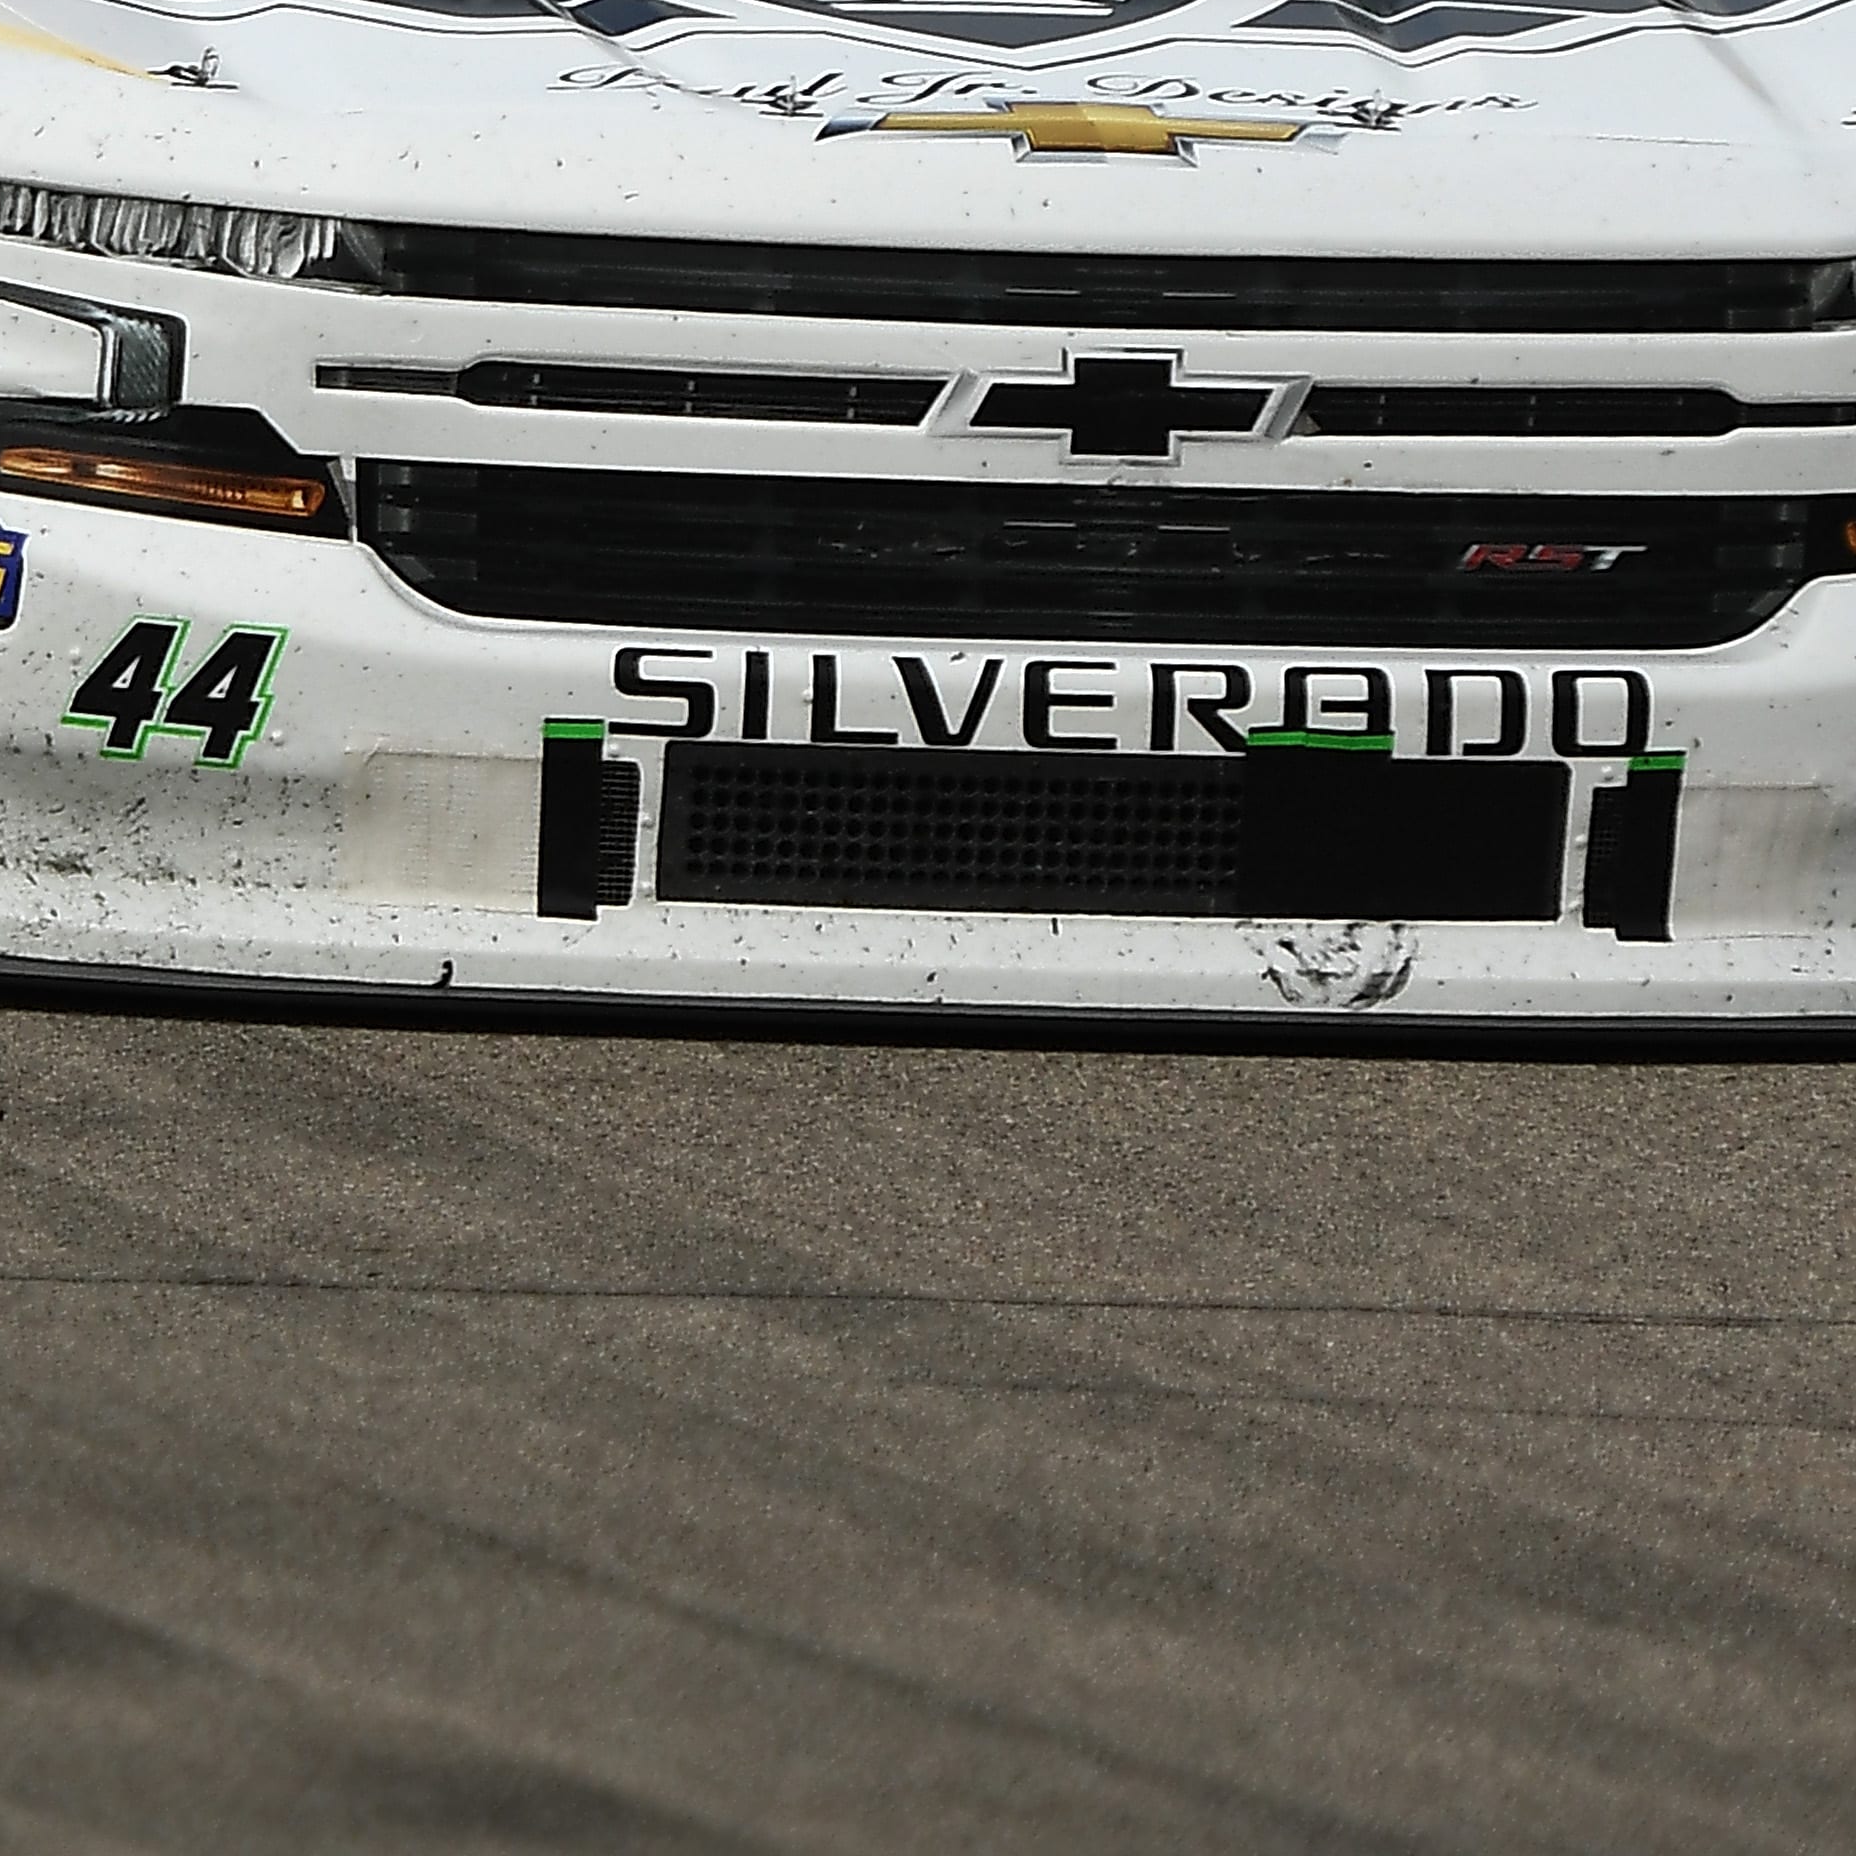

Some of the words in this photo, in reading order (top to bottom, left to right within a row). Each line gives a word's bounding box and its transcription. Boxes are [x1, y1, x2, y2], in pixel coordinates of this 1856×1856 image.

[1456, 543, 1647, 572] RST
[61, 614, 290, 770] 44
[608, 645, 1650, 759] SILVERADO
